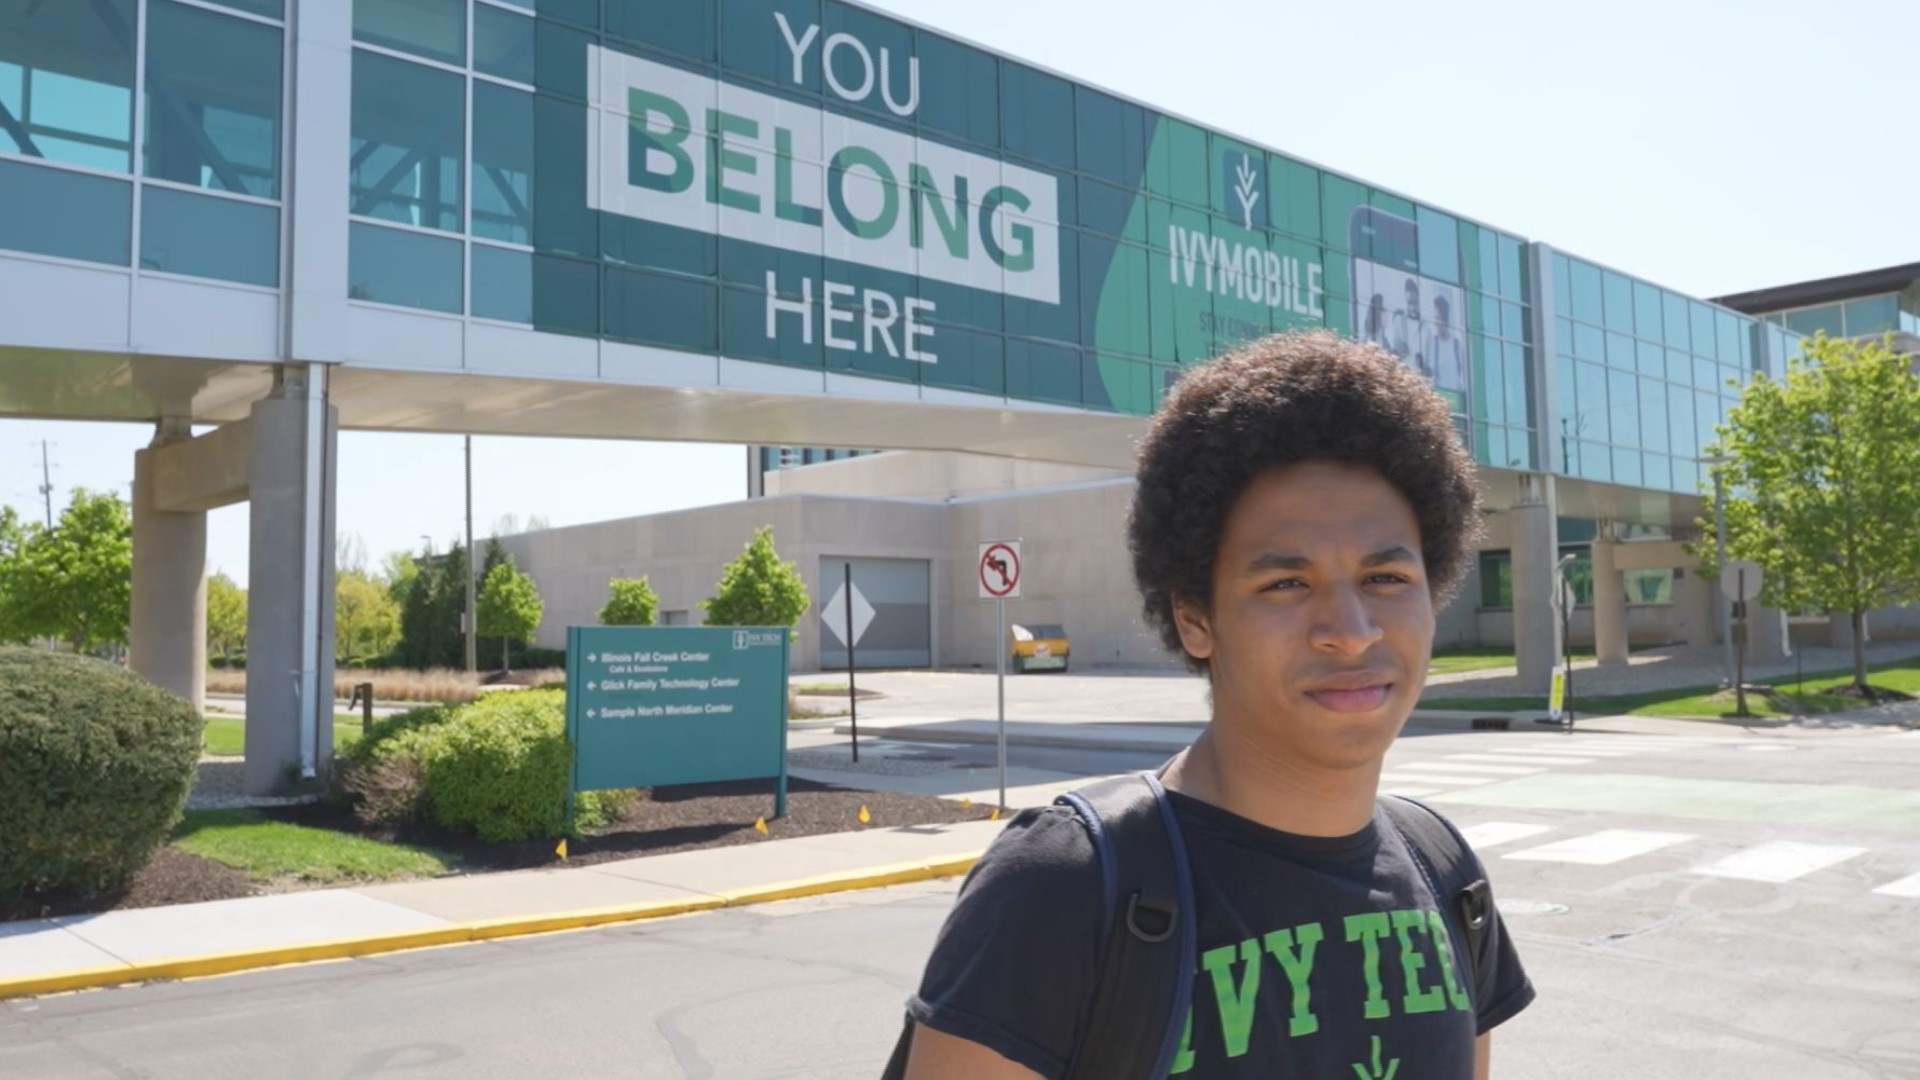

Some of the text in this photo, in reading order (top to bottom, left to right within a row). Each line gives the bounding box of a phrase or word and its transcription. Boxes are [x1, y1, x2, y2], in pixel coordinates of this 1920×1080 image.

[774, 12, 919, 116] YOU
[627, 86, 1035, 273] BELONG
[765, 270, 938, 364] HERE
[1168, 224, 1324, 319] IVYMOBILE
[601, 652, 710, 663] Illinois Fall Creek Center
[601, 677, 740, 691] Glick Family Technology Center
[601, 703, 733, 718] Sample North Meridian Center
[1170, 909, 1471, 1075] VY TEC
